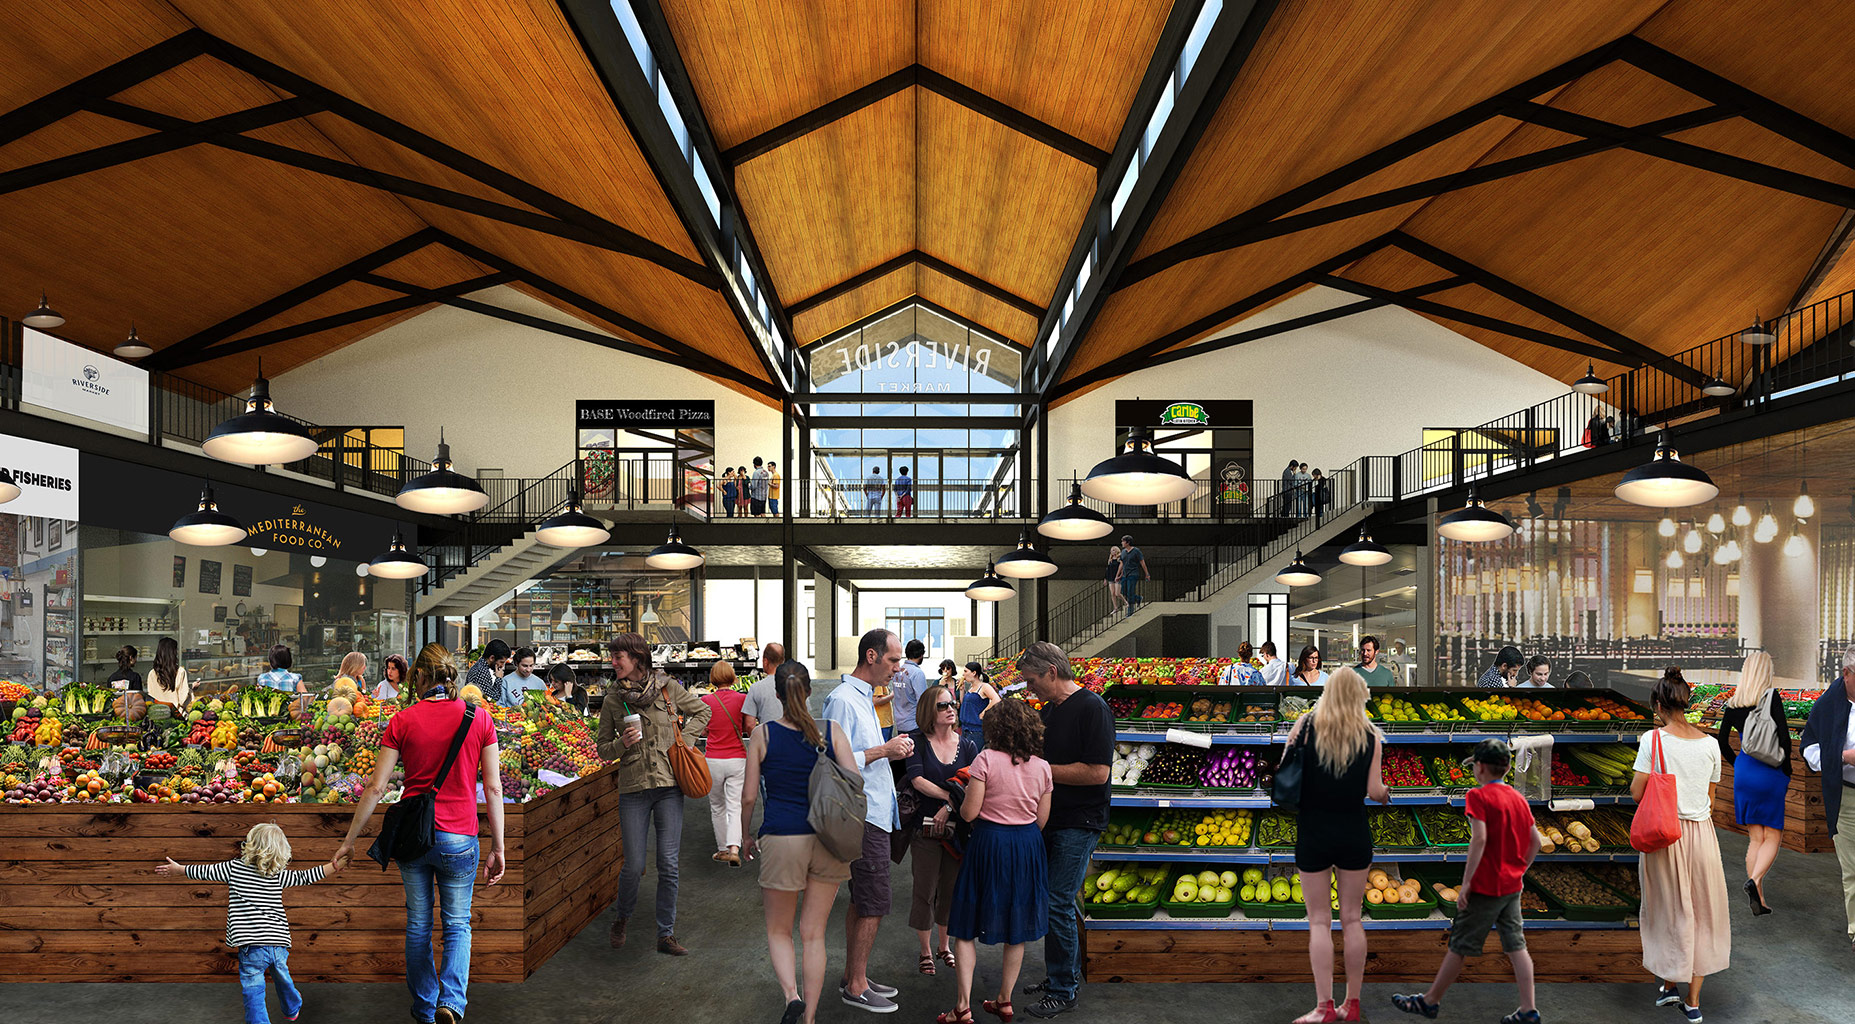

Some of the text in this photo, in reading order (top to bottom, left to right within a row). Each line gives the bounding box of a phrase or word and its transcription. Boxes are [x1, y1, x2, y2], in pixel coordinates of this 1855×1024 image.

[72, 378, 110, 395] RIVERSIDE
[580, 409, 710, 420] BASE Woodfired Pizza
[13, 469, 72, 491] FISHERIES
[292, 503, 306, 516] the
[247, 519, 342, 549] MEDITERRANEAN
[273, 533, 325, 549] FOOD CO.
